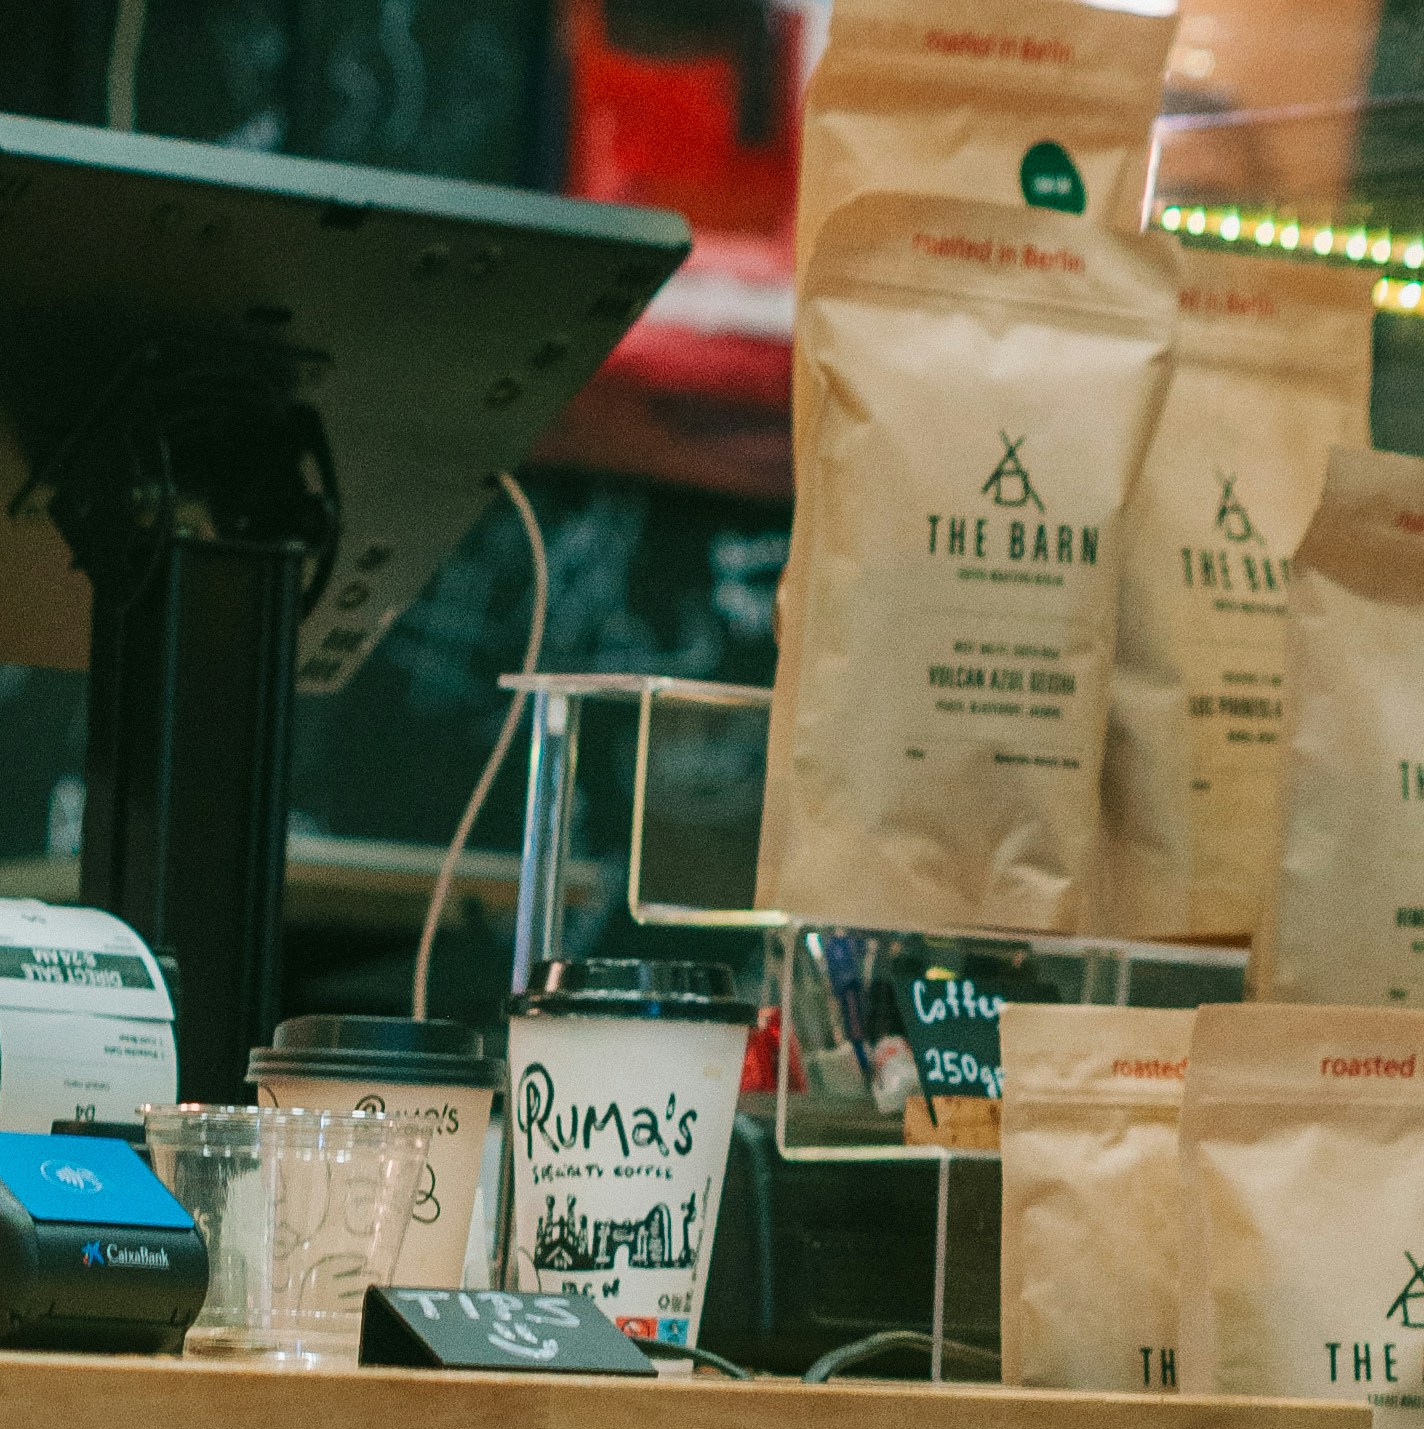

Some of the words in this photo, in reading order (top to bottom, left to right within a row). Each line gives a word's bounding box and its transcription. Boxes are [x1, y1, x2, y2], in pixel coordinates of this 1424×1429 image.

[927, 514, 988, 558] THE
[1009, 520, 1099, 566] BARN
[1320, 1053, 1417, 1079] roasted
[106, 1243, 170, 1268] CaixaBank
[396, 1289, 580, 1328] TIPS
[1140, 1346, 1177, 1387] TH
[1325, 1342, 1398, 1383] THE
